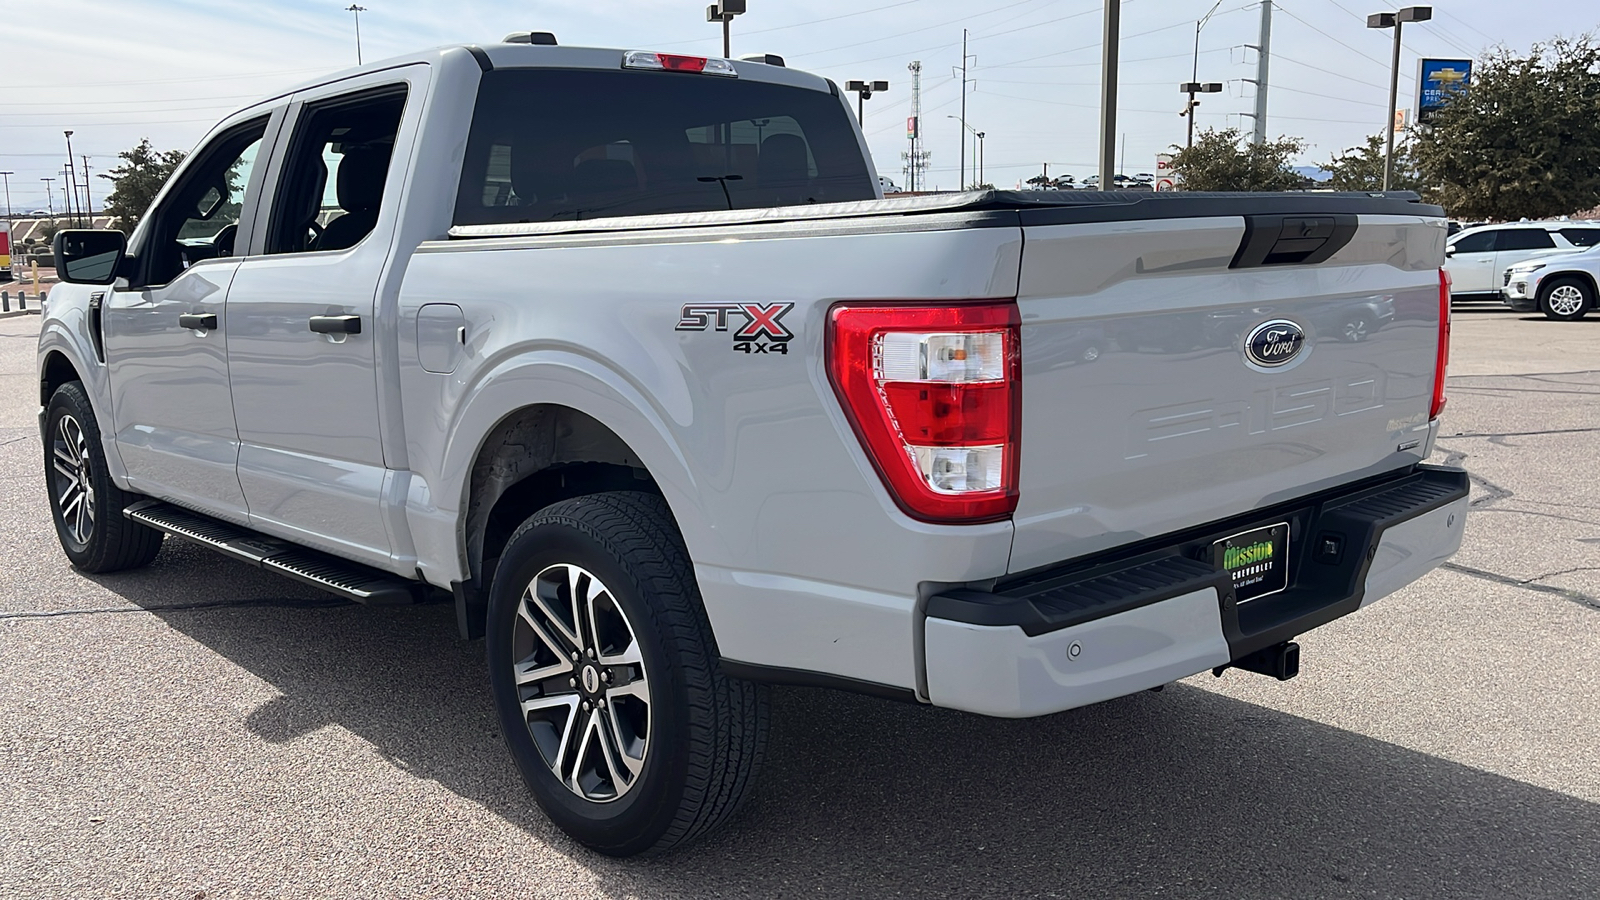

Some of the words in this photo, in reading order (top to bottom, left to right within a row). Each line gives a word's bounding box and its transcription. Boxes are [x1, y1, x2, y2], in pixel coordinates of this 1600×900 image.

[675, 301, 795, 342] STX
[1263, 330, 1295, 357] Ford
[1223, 541, 1273, 570] Mission
[1232, 561, 1273, 581] CHEVROLET
